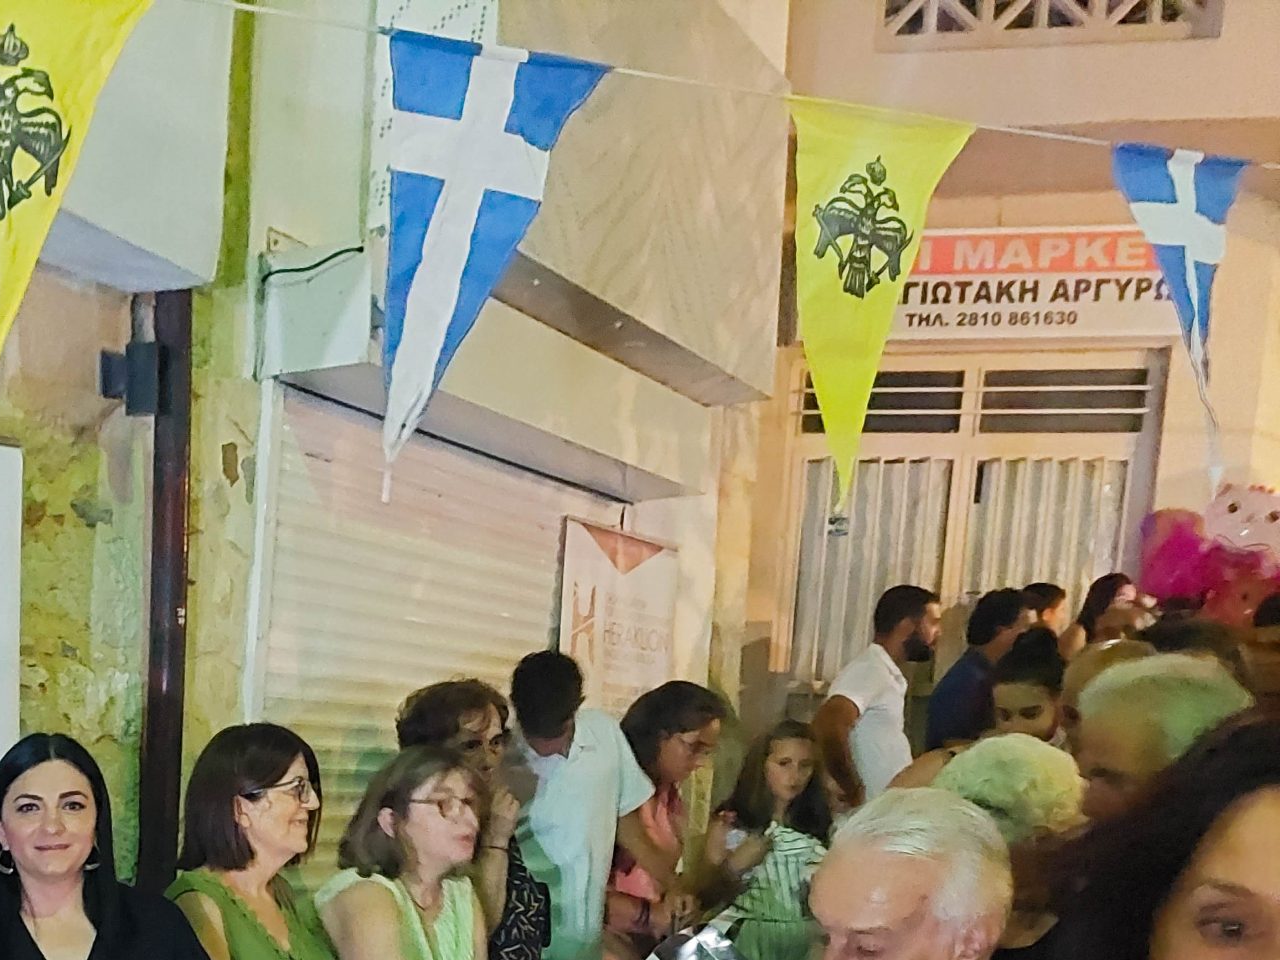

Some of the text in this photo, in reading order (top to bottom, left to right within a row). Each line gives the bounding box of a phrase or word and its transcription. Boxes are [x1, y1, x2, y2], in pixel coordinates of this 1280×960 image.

[953, 236, 1147, 271] ΜΑΡΚΕ
[900, 276, 1173, 305] ΓΙΩΤΑΚΗ ΑΡΓΥΡΩ
[905, 310, 1078, 328] ΤΗΛ. 2810 861630
